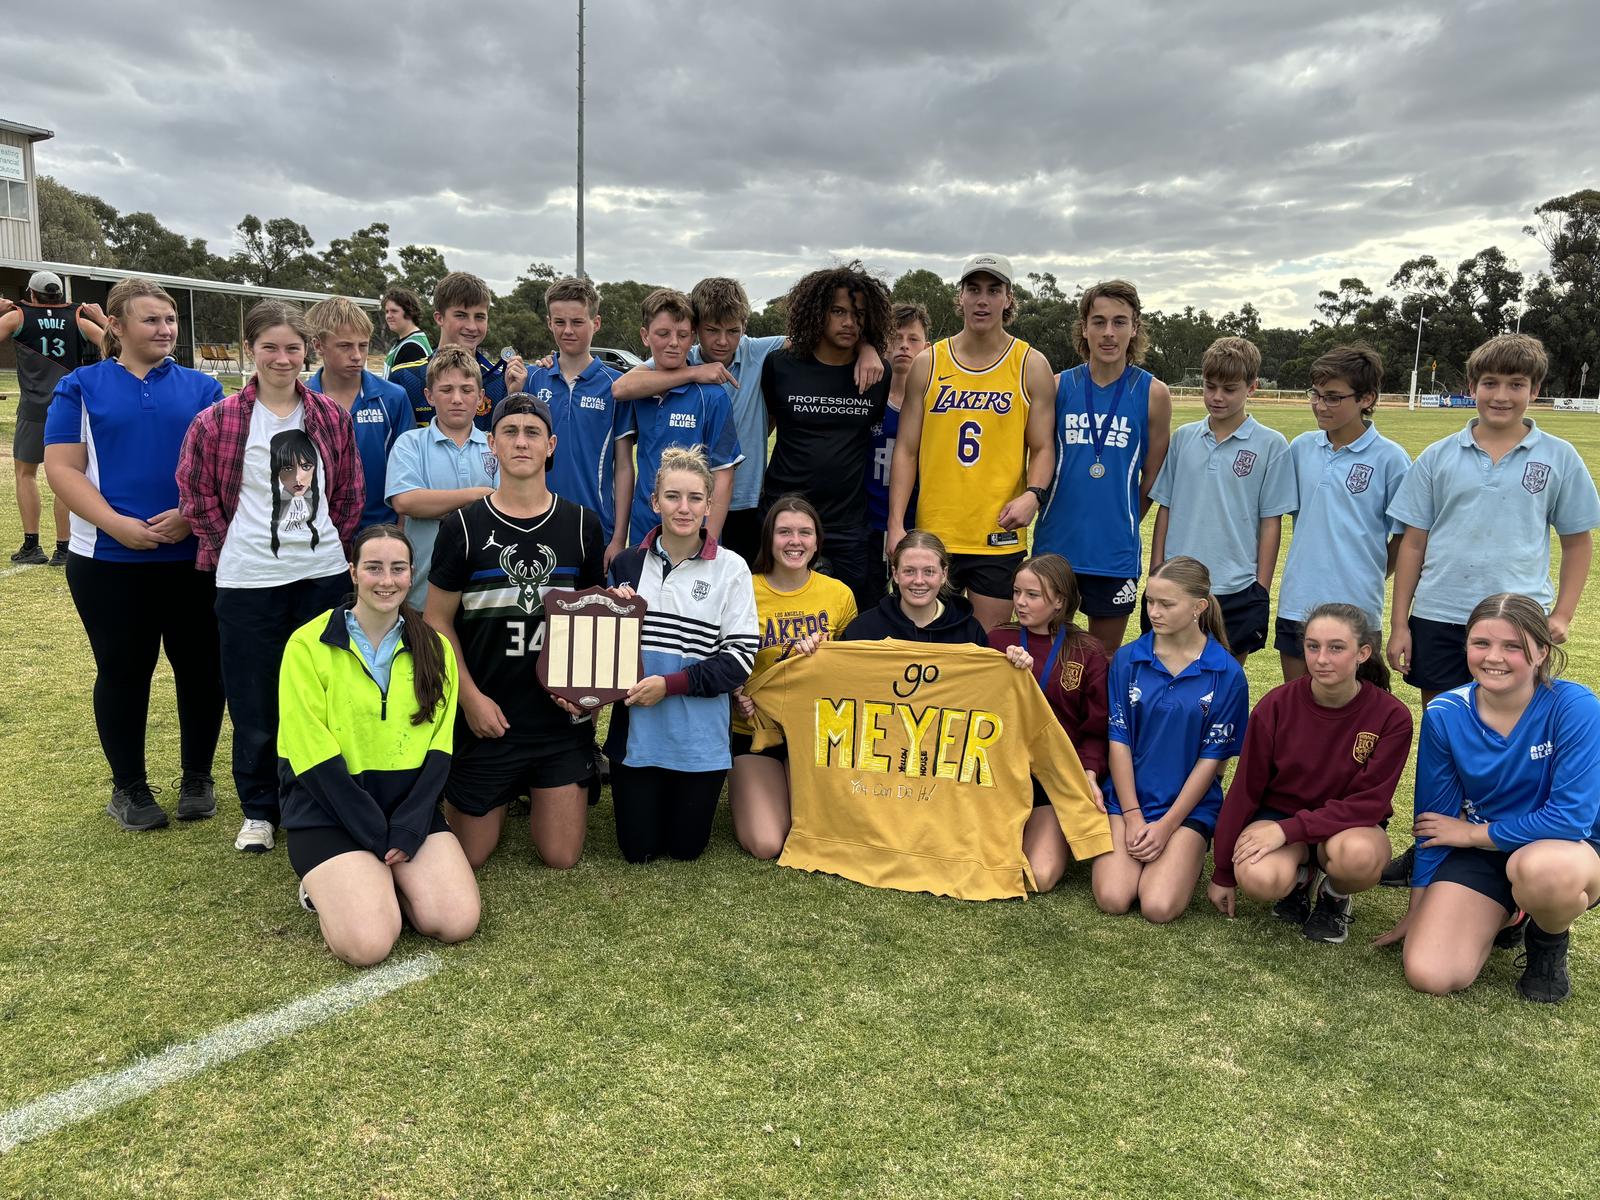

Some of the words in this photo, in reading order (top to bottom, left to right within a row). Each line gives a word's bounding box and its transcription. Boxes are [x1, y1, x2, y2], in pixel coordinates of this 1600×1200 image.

[37, 317, 66, 330] POOLE
[40, 336, 65, 357] 13
[580, 402, 605, 410] BLUES
[581, 395, 606, 405] ROYAL
[788, 395, 874, 407] PROFESSIONAL
[929, 384, 1014, 415] LAKERS
[670, 413, 697, 422] ROYAL
[793, 404, 869, 415] RAWDOGGER
[669, 420, 697, 428] BLUES
[1065, 412, 1132, 433] ROYAL
[957, 420, 982, 467] 6
[1112, 592, 1137, 605] adid
[505, 621, 546, 656] 34
[757, 609, 829, 651] AKERS
[893, 663, 940, 698] go
[1210, 722, 1234, 738] 50
[815, 697, 1003, 788] MEYER
[920, 750, 928, 777] HOUSE
